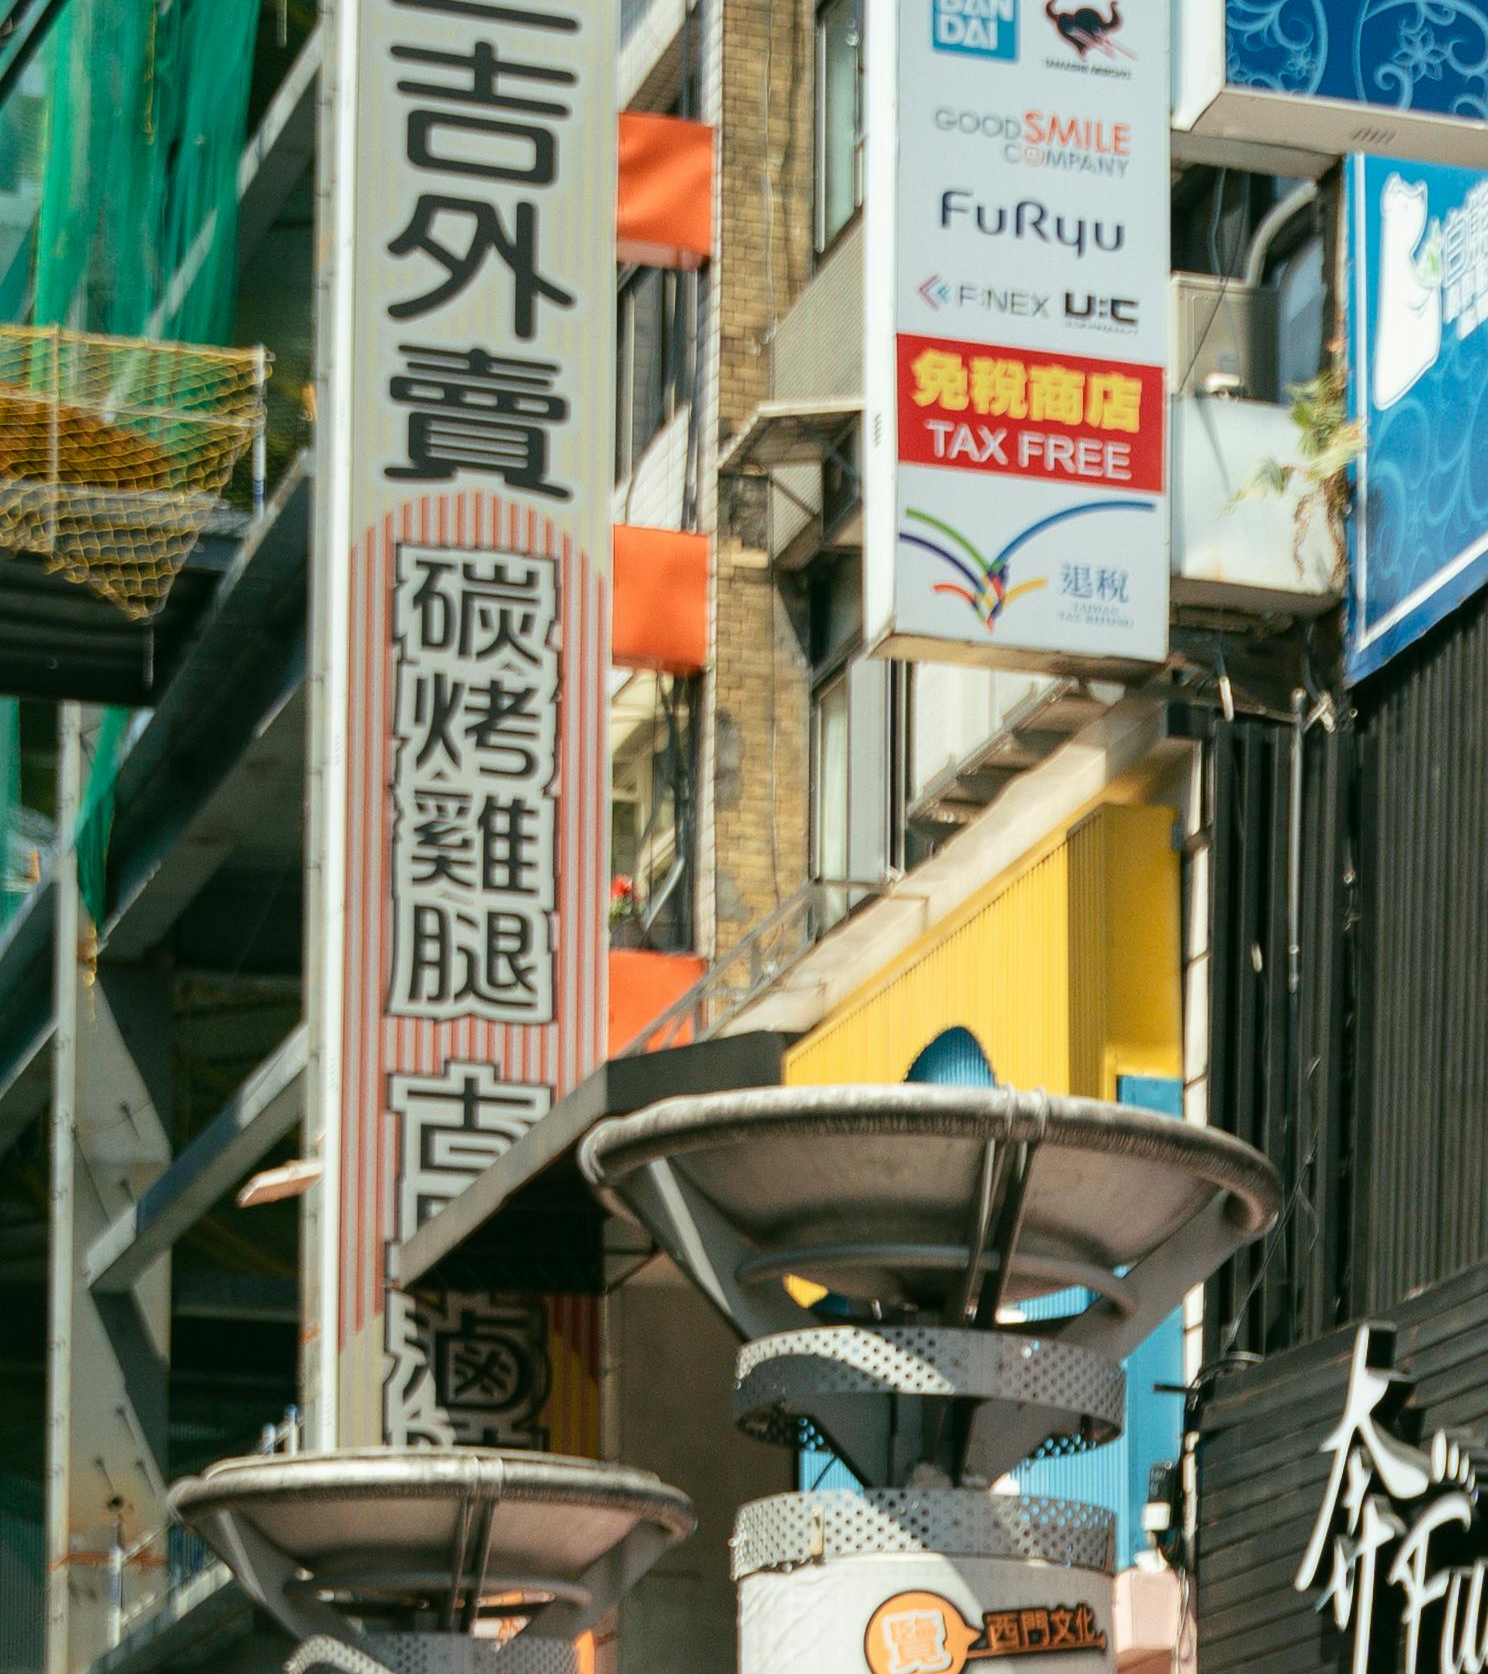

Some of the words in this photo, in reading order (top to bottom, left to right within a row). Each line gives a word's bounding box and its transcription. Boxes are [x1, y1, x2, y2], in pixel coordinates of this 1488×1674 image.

[937, 15, 999, 52] DAI
[1003, 144, 1130, 179] COMPANY
[940, 189, 1126, 259] FuRyu
[911, 347, 1144, 434] 免稅商店
[925, 420, 1009, 466] TAX
[1018, 431, 1132, 480] FREE
[1060, 563, 1130, 604] 退稅
[406, 552, 547, 1012] 碳烤雞腿
[984, 1604, 1097, 1651] 西門文化
